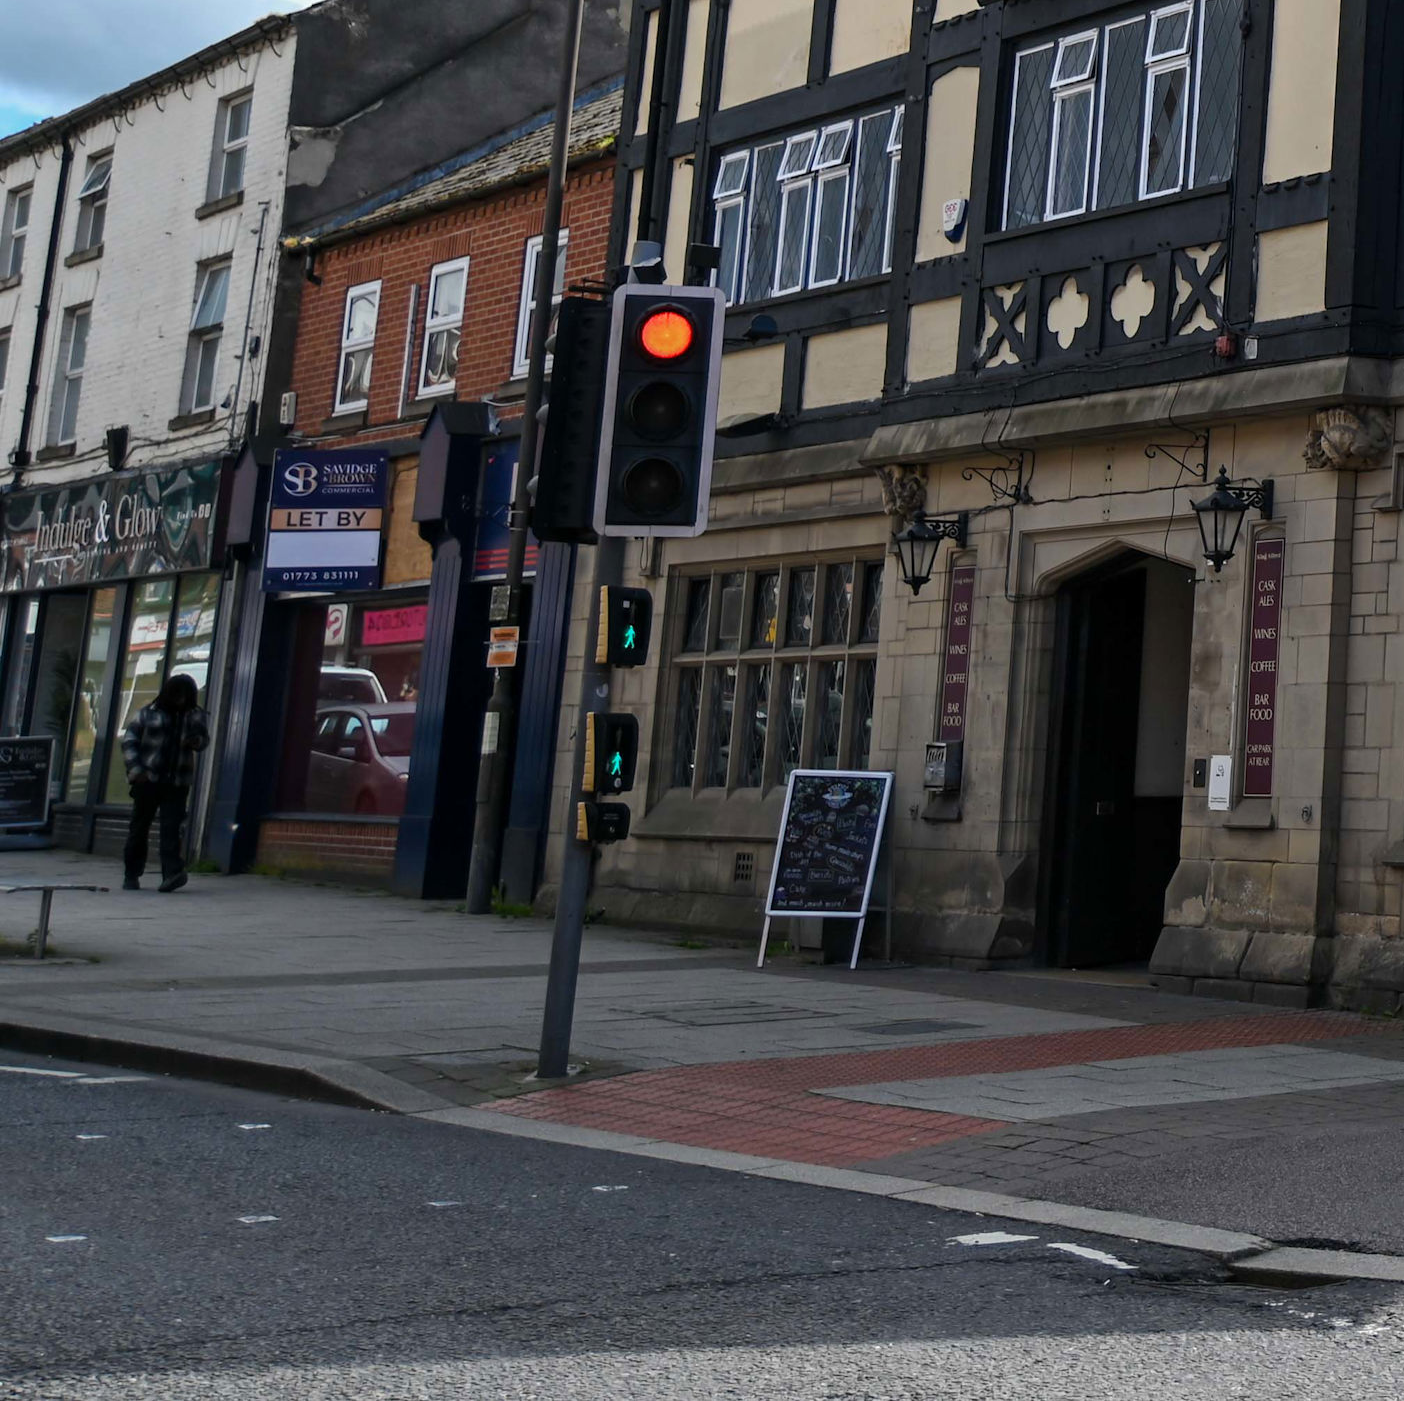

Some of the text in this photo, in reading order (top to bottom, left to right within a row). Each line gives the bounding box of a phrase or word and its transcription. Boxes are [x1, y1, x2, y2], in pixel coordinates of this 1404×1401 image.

[323, 464, 377, 475] SAVIDGE
[329, 473, 376, 484] BROWN
[34, 495, 162, 552] Indulge & Glow
[286, 511, 366, 527] LET BY
[282, 572, 317, 580] 01773
[1258, 580, 1276, 591] CASK
[1258, 596, 1275, 606] ALES
[954, 603, 969, 613] CASK
[954, 615, 967, 625] ALES
[1254, 628, 1276, 640] WINES
[950, 645, 967, 655] WINES
[1251, 661, 1276, 672] COFFEE
[946, 673, 967, 684] COFFEE
[1254, 694, 1269, 705] BAR
[947, 703, 960, 713] BAR
[1250, 708, 1273, 720] FOOD
[943, 715, 962, 727] FOOD
[1247, 744, 1272, 753] CAR PARK
[1248, 757, 1270, 766] AT REAR
